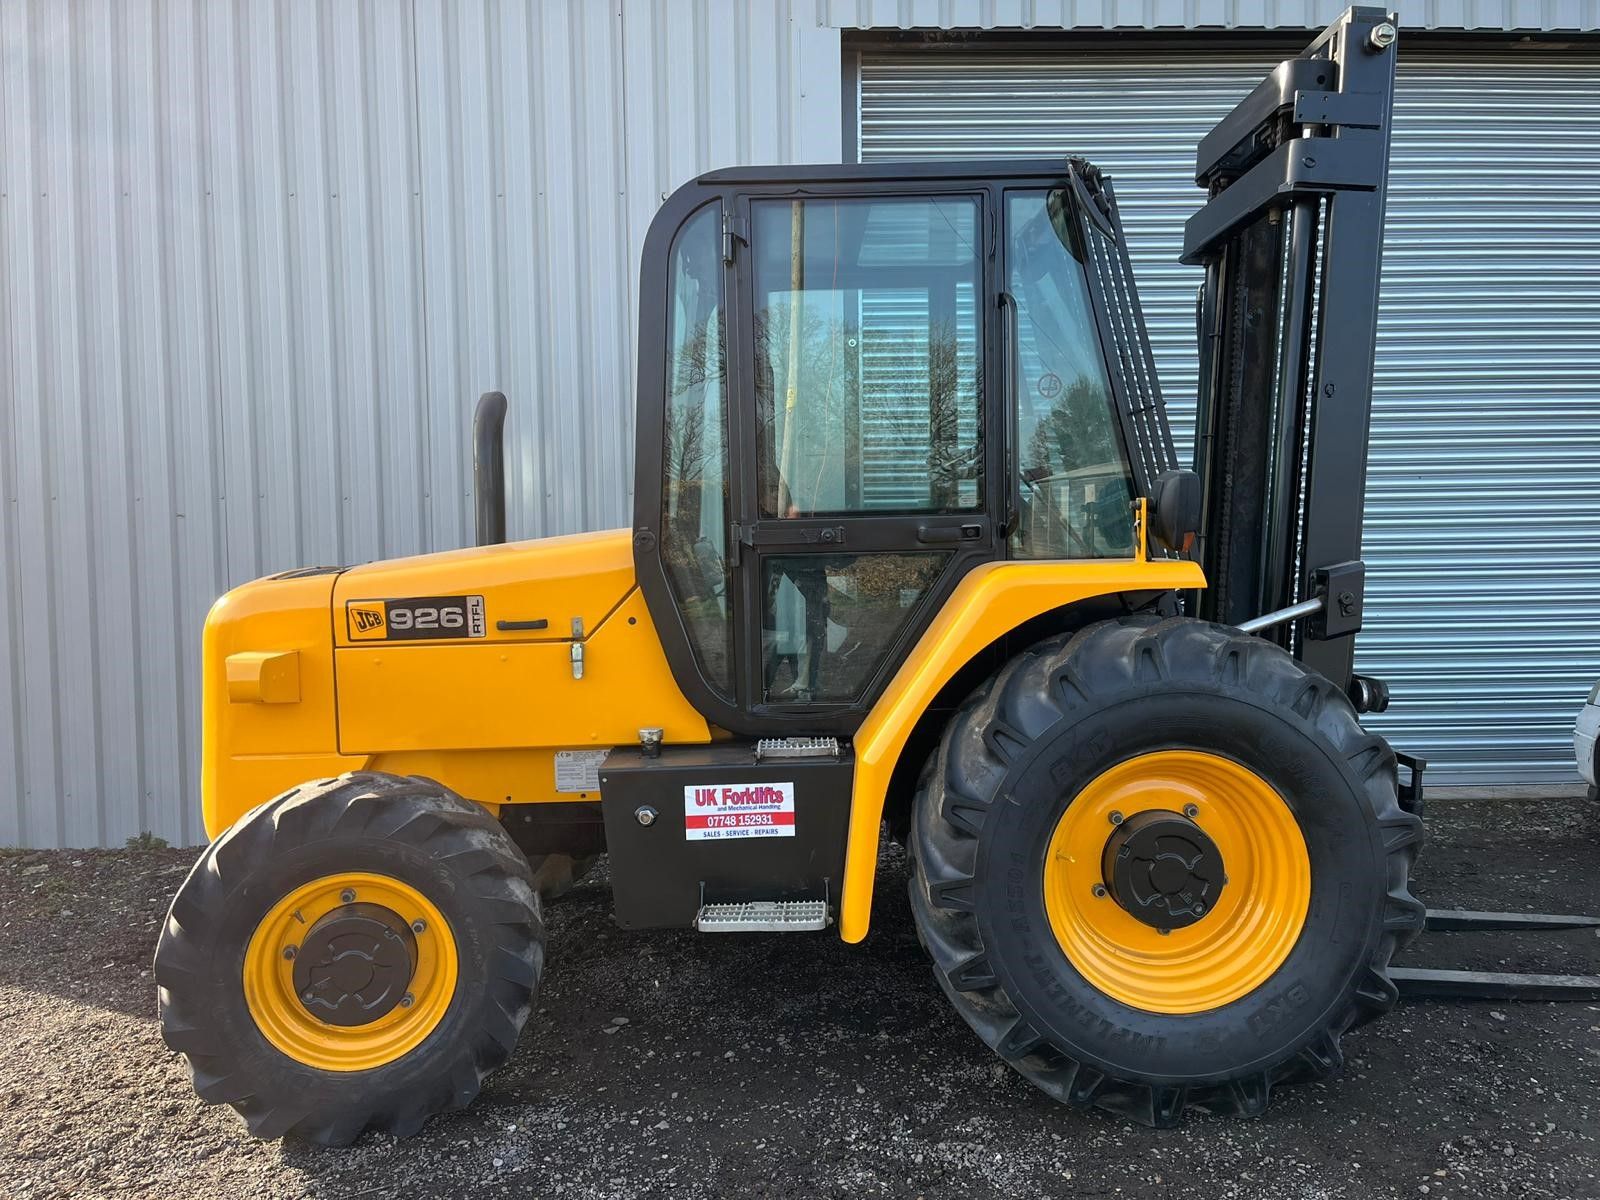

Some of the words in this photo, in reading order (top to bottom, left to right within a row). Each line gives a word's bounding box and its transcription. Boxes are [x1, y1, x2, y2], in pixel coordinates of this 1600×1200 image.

[356, 611, 382, 630] JCB
[389, 607, 464, 630] 926
[471, 599, 482, 634] RTFL
[695, 788, 718, 807] UK
[722, 787, 784, 805] Forklifts
[707, 815, 736, 827] 07748
[738, 814, 774, 826] 152931
[726, 829, 749, 837] SERVICE
